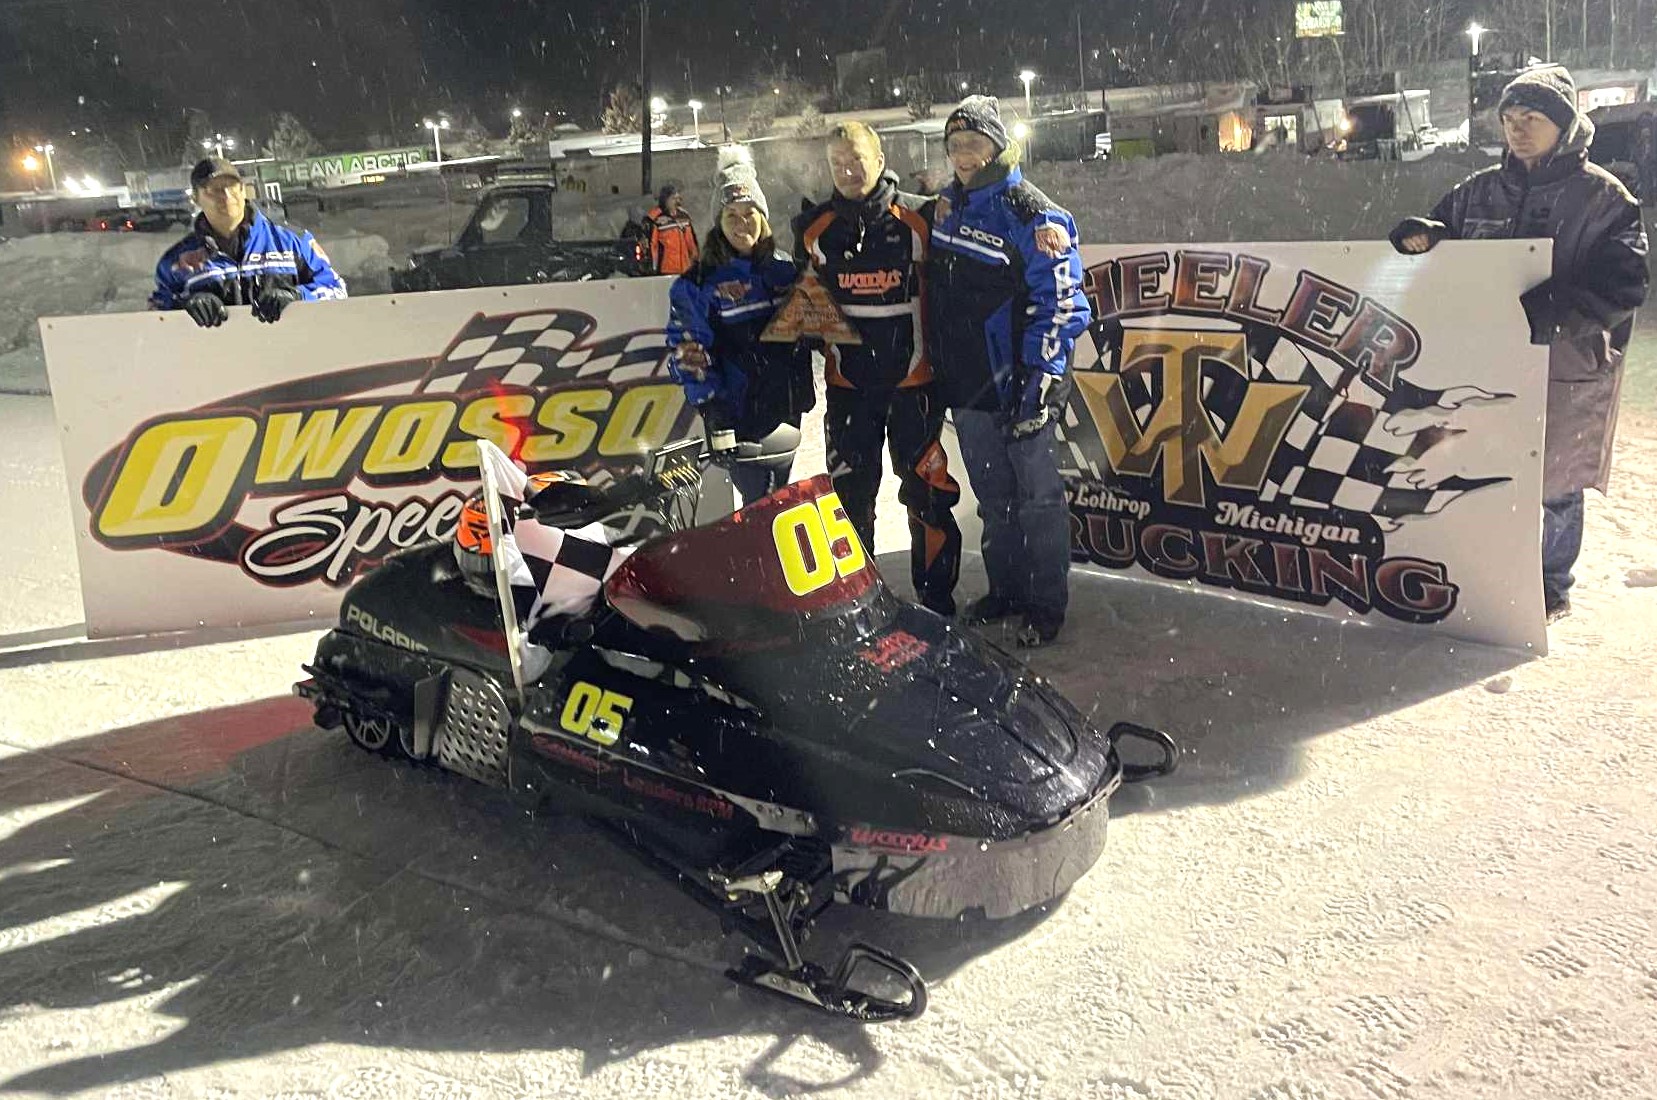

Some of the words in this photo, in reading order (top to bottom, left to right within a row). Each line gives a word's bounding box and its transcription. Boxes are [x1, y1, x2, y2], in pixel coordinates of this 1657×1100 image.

[280, 160, 343, 183] TEAM
[350, 151, 421, 173] ARCTIC
[1083, 251, 1422, 396] HEELER
[99, 384, 687, 538] OWOSSO
[1075, 484, 1150, 520] Lothrop
[244, 495, 467, 581] Spee
[772, 491, 867, 597] 05
[1069, 511, 1457, 616] RUCKING
[1214, 501, 1361, 546] Michigan
[560, 680, 635, 746] 05
